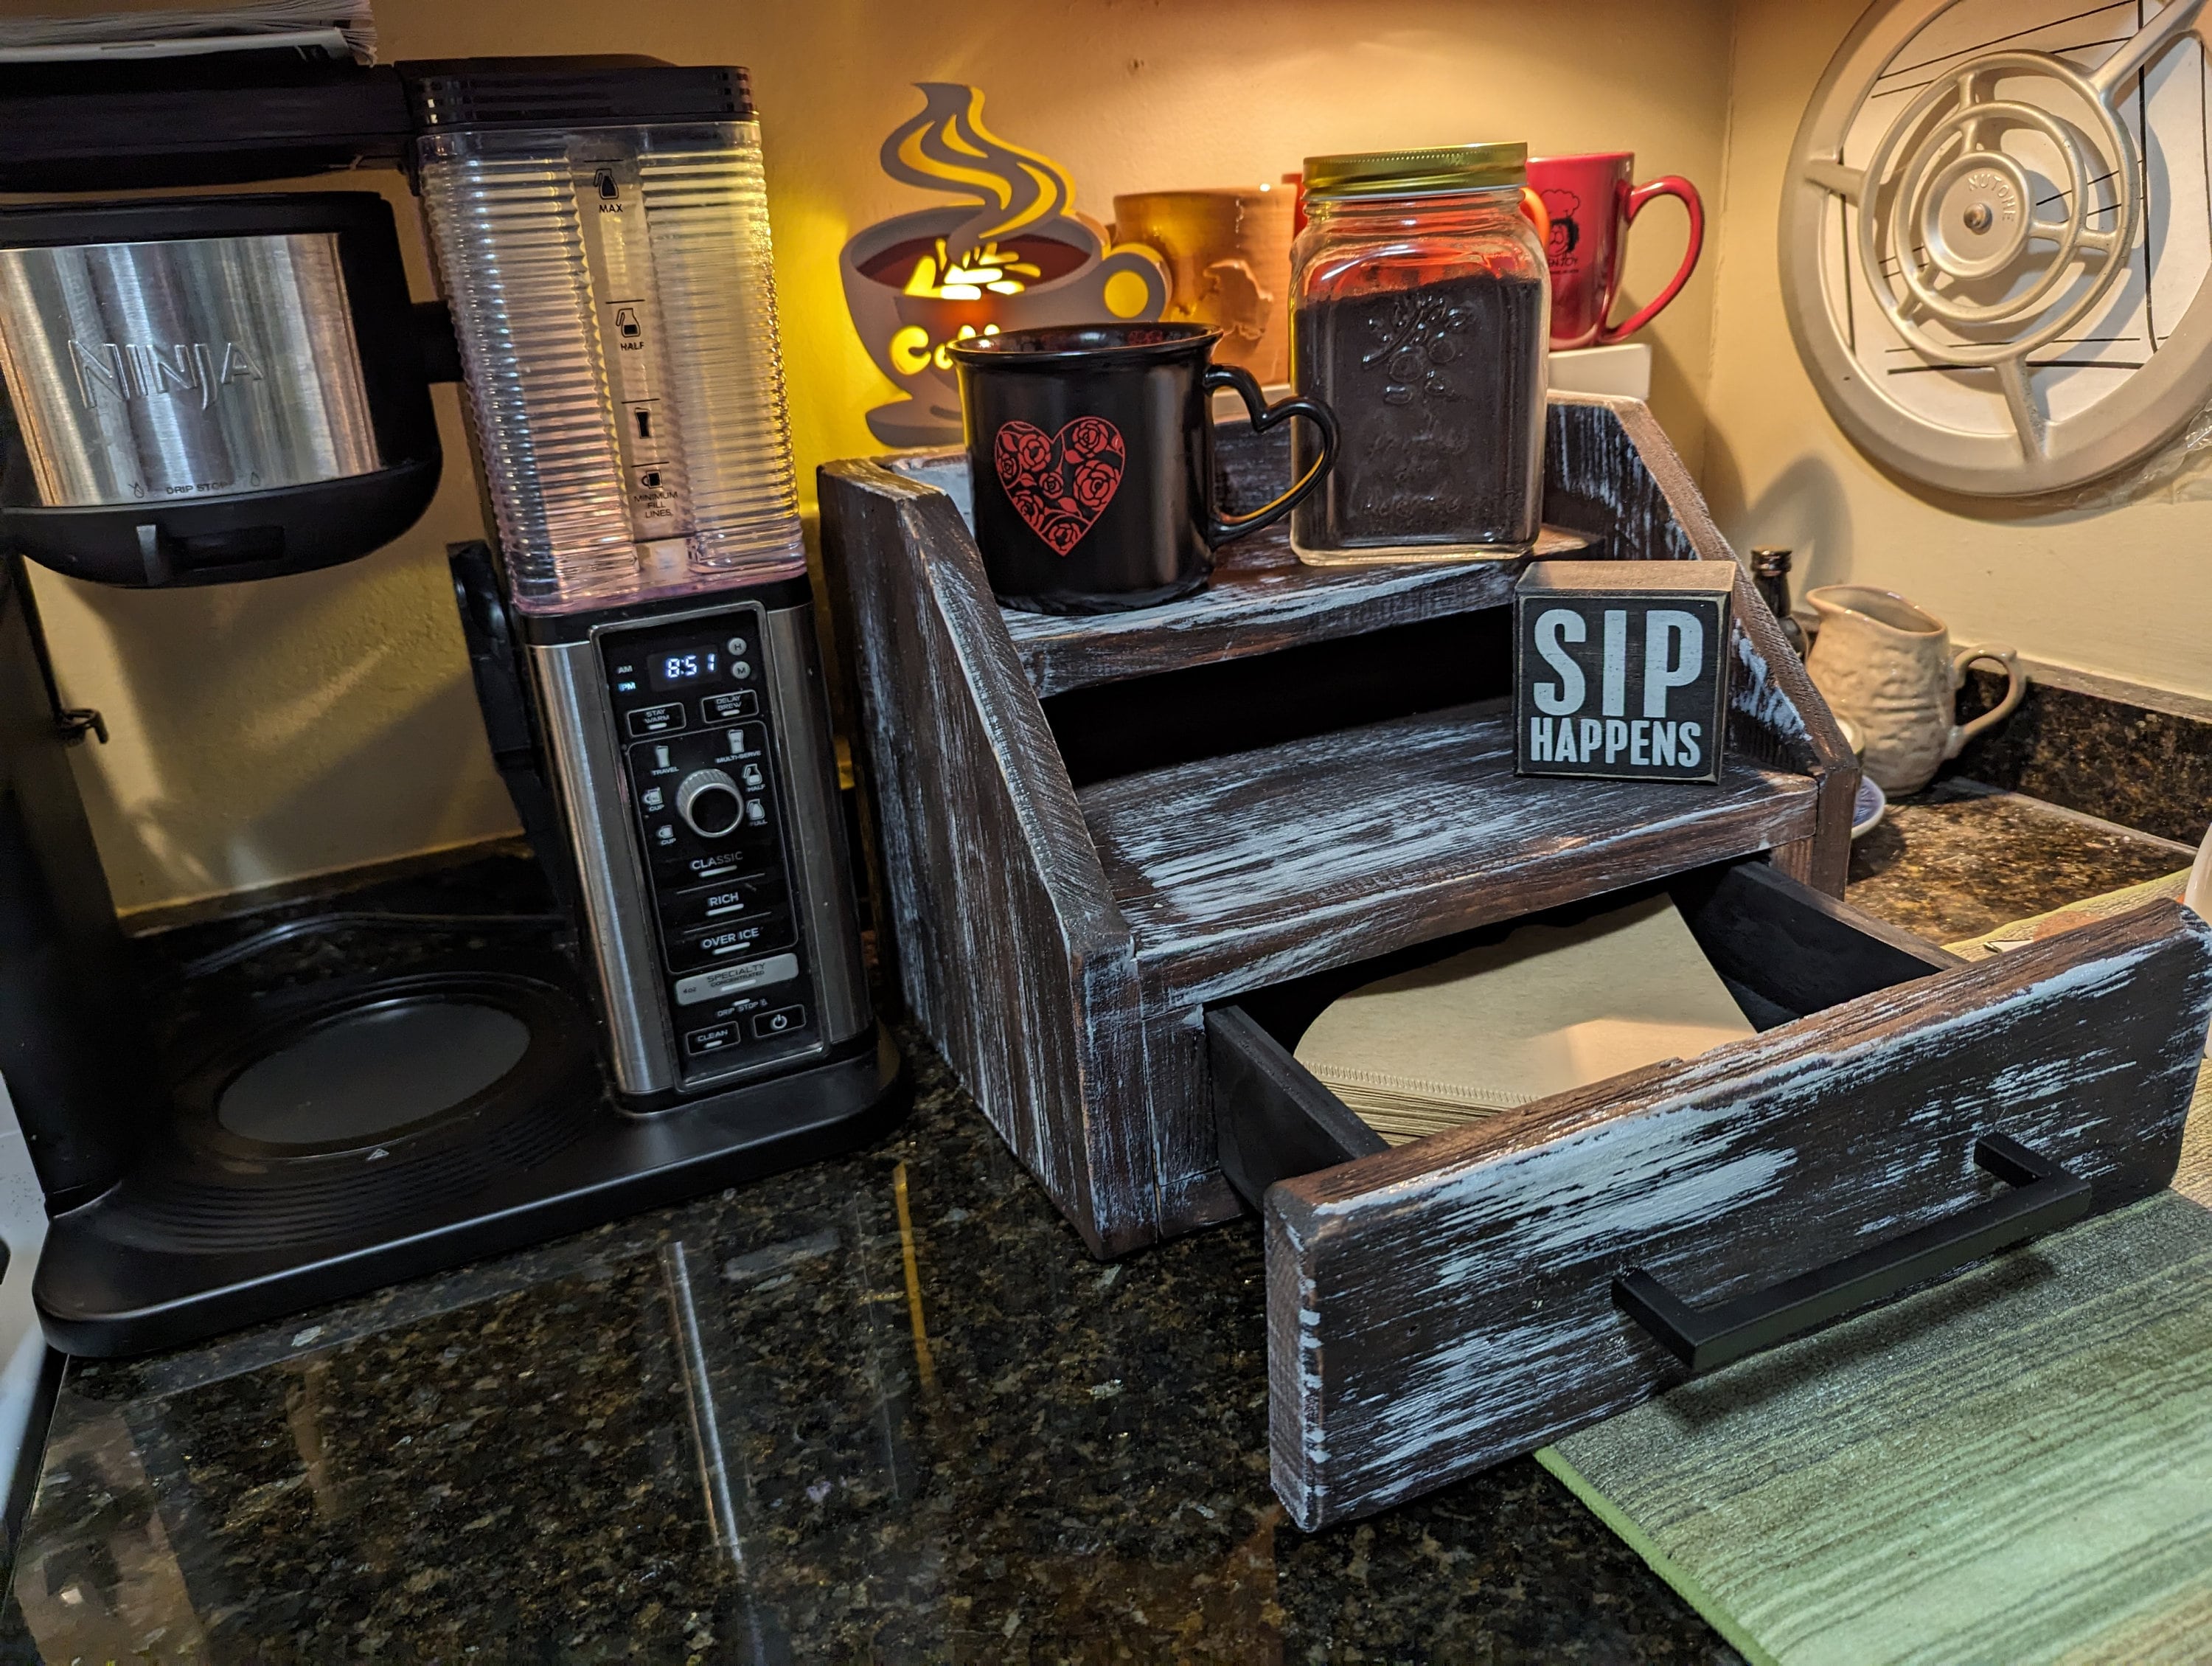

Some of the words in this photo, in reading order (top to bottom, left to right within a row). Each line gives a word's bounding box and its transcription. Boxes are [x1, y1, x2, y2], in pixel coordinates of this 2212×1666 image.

[599, 204, 624, 213] MAX
[620, 341, 644, 351] HALF
[67, 339, 264, 411] NINJA
[166, 485, 193, 495] DRIP
[634, 492, 678, 502] MINIMUM
[666, 653, 717, 678] 8:51
[1533, 608, 1703, 718] SIP
[618, 665, 633, 674] AM
[618, 681, 636, 693] PM
[716, 695, 742, 705] DELAY
[717, 701, 742, 712] BREW
[645, 708, 666, 718] STAY
[644, 715, 670, 724] WARM
[1531, 717, 1701, 768] HAPPENS
[715, 750, 762, 763] MULTI-SERVE
[651, 766, 680, 776] TRAVEL
[747, 783, 766, 792] HALF
[649, 804, 665, 812] CUP
[749, 819, 768, 827] FULL
[660, 837, 677, 846] CUP
[692, 851, 743, 870] CLASSIC
[707, 892, 740, 907] RICH
[703, 932, 737, 949] OVER
[739, 926, 760, 940] ICE
[706, 962, 766, 983] SPECIALTY
[717, 1007, 736, 1017] DRIP
[738, 1001, 759, 1011] STOP
[698, 1030, 728, 1041] CLEAN
